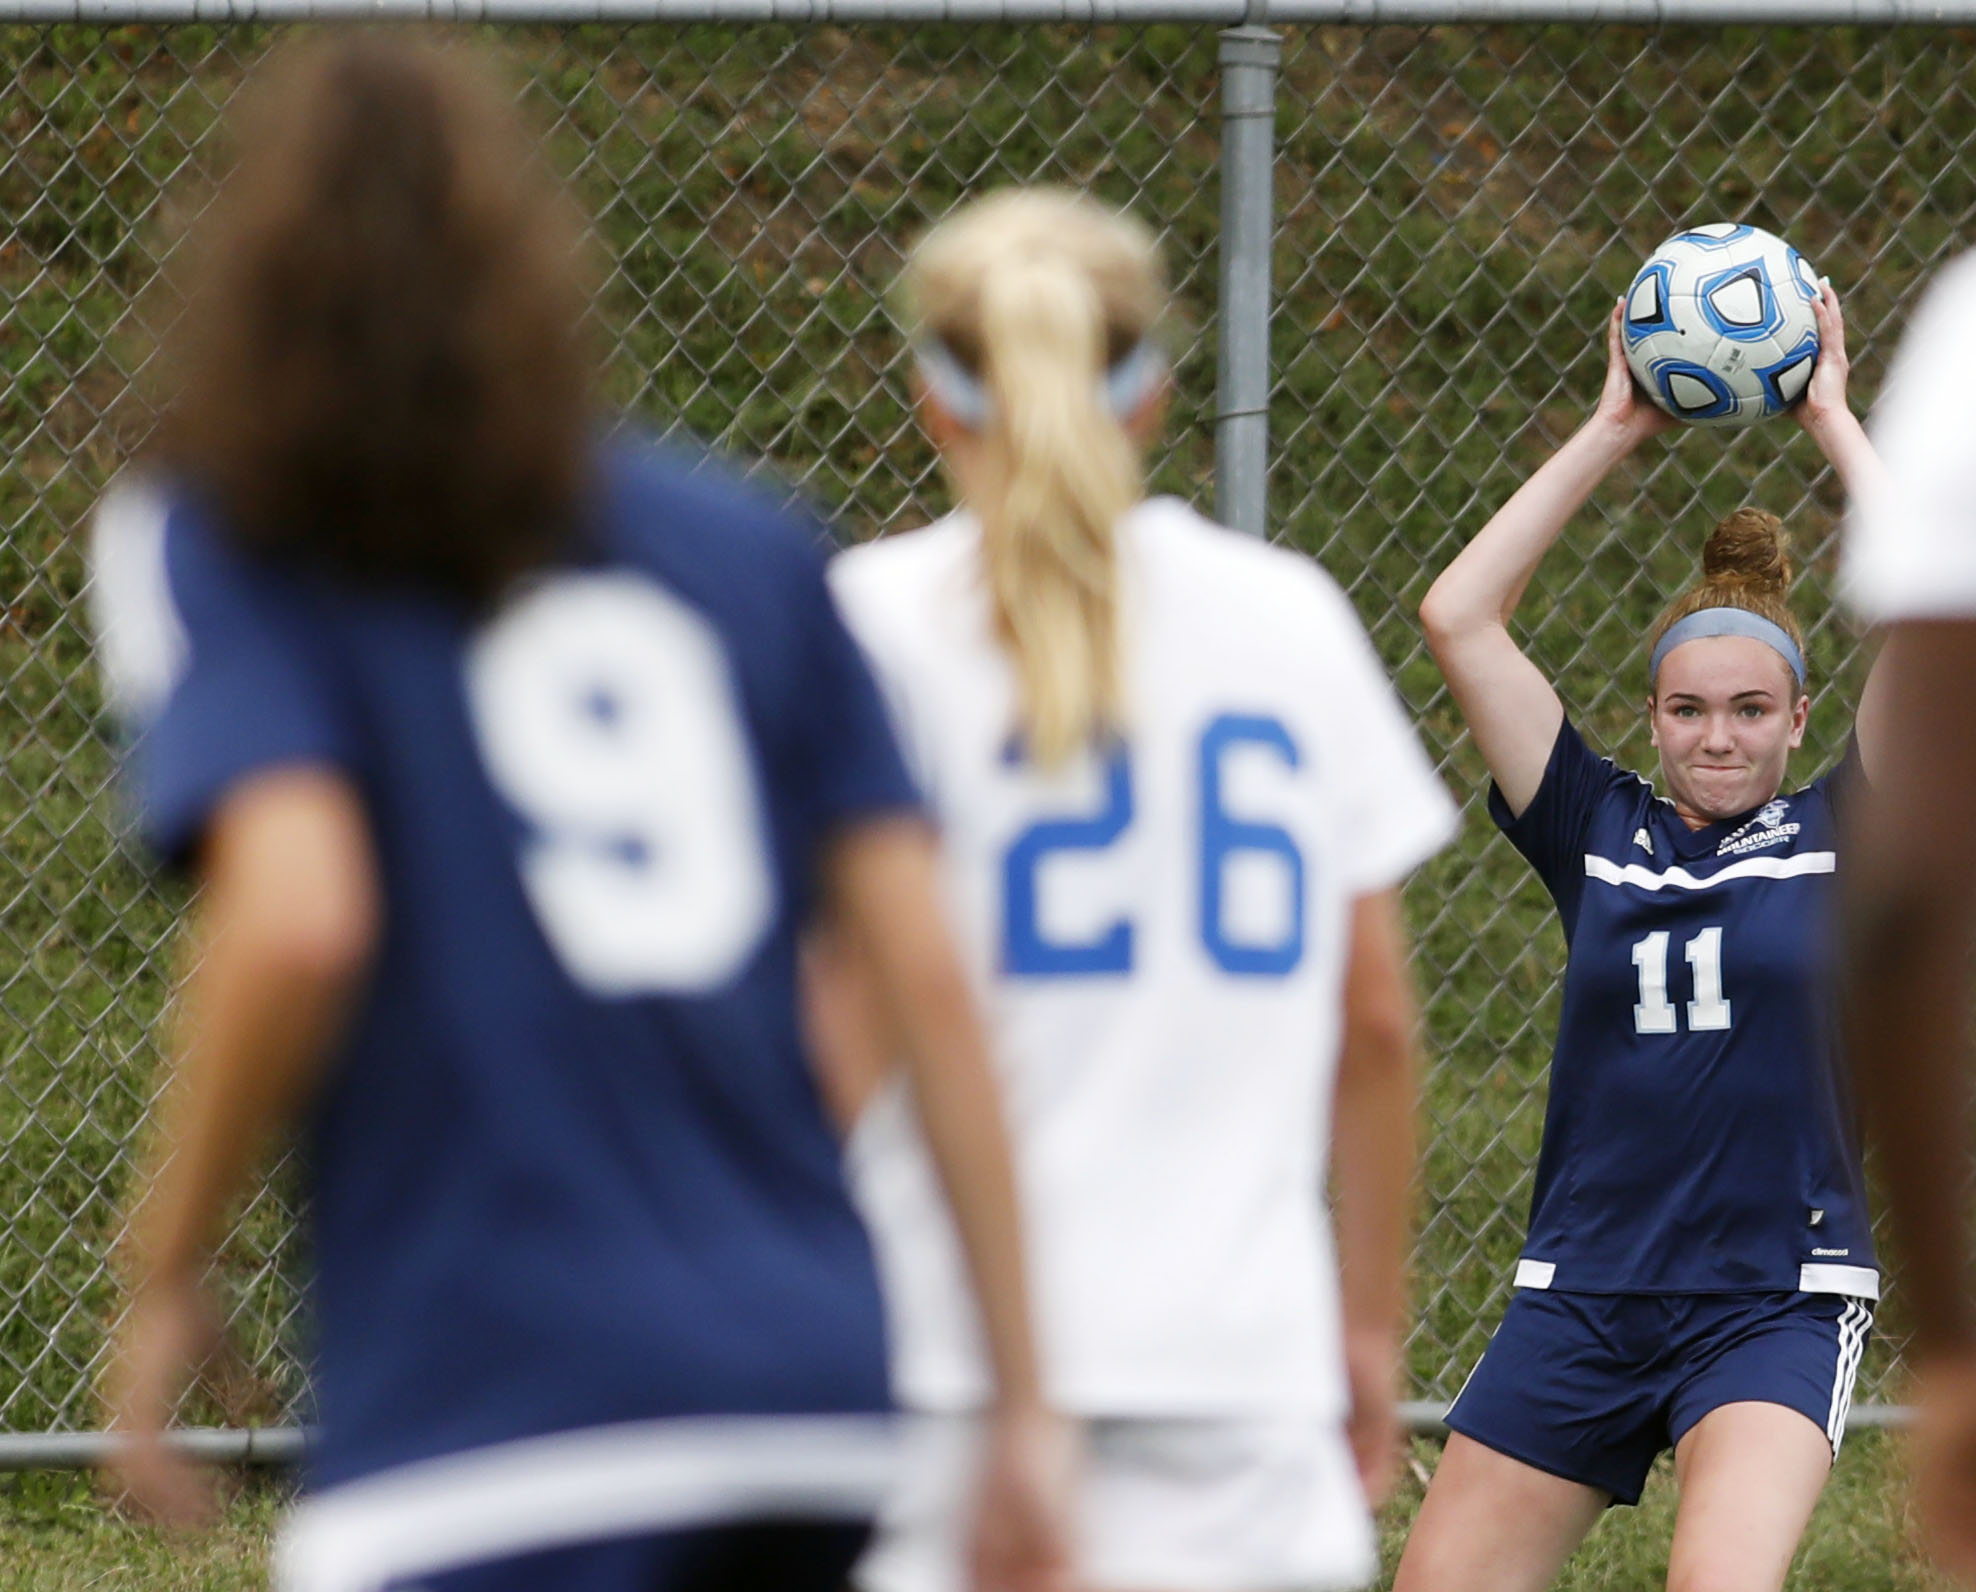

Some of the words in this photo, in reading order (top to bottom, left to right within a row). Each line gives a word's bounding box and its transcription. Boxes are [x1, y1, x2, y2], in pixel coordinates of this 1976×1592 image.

[465, 568, 781, 1001] 9
[1002, 713, 1305, 976] 26
[1632, 927, 1731, 1034] 11
